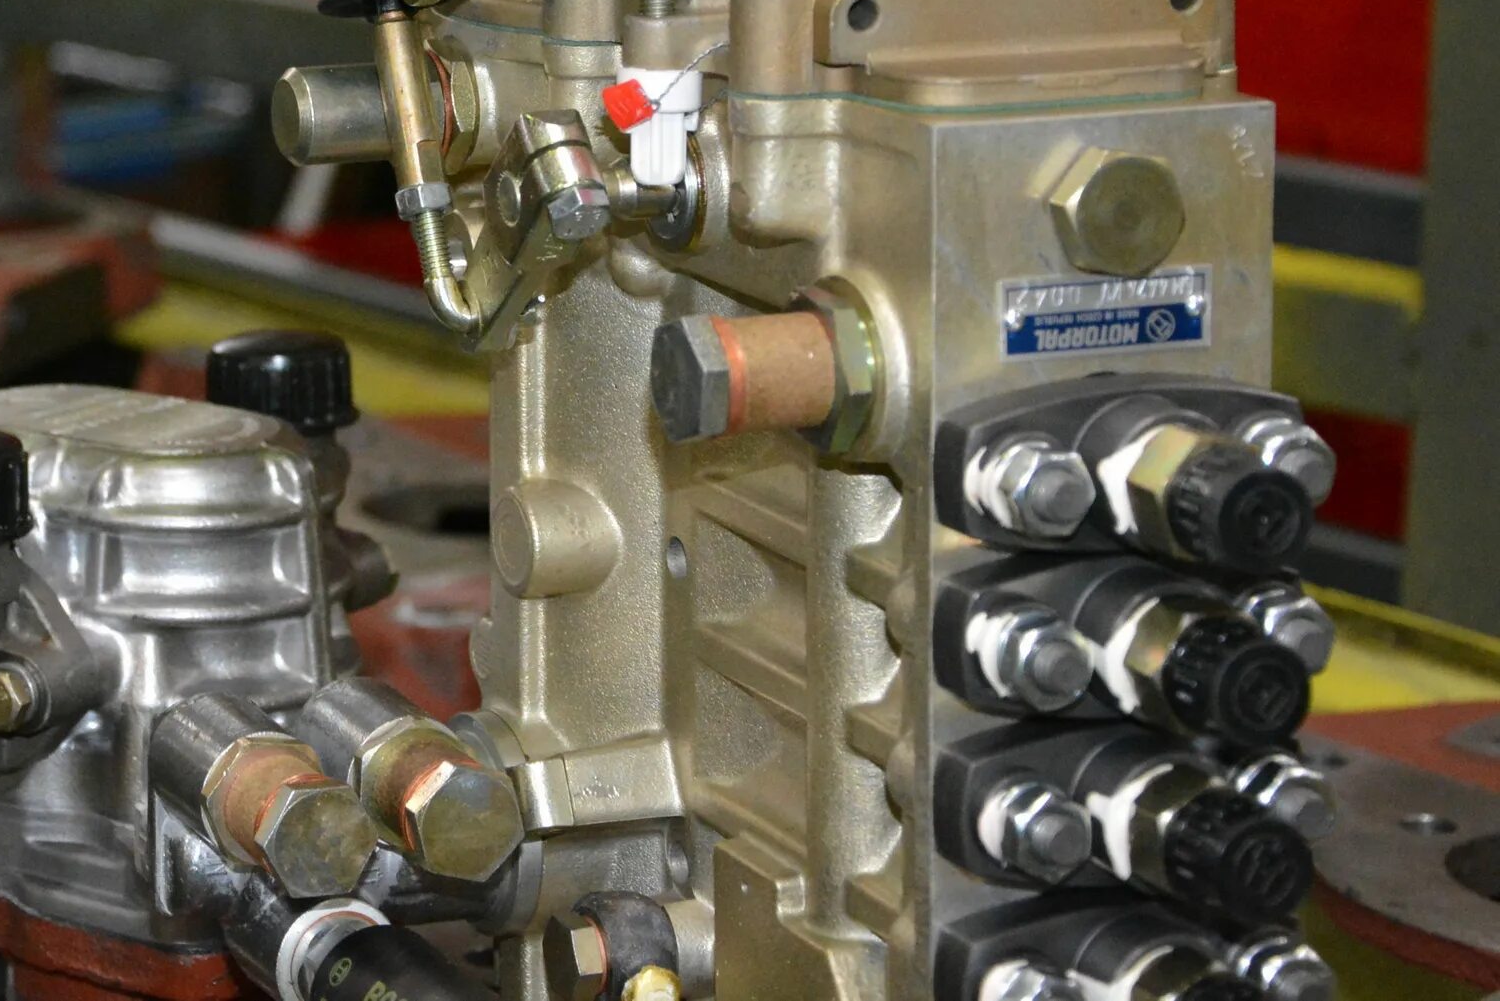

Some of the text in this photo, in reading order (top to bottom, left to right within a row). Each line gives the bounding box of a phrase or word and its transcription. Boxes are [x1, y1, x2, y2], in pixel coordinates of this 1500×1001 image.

[1034, 314, 1074, 326] REPUBLIC
[1117, 309, 1140, 319] MADE
[1035, 321, 1140, 351] MOTORPAL
